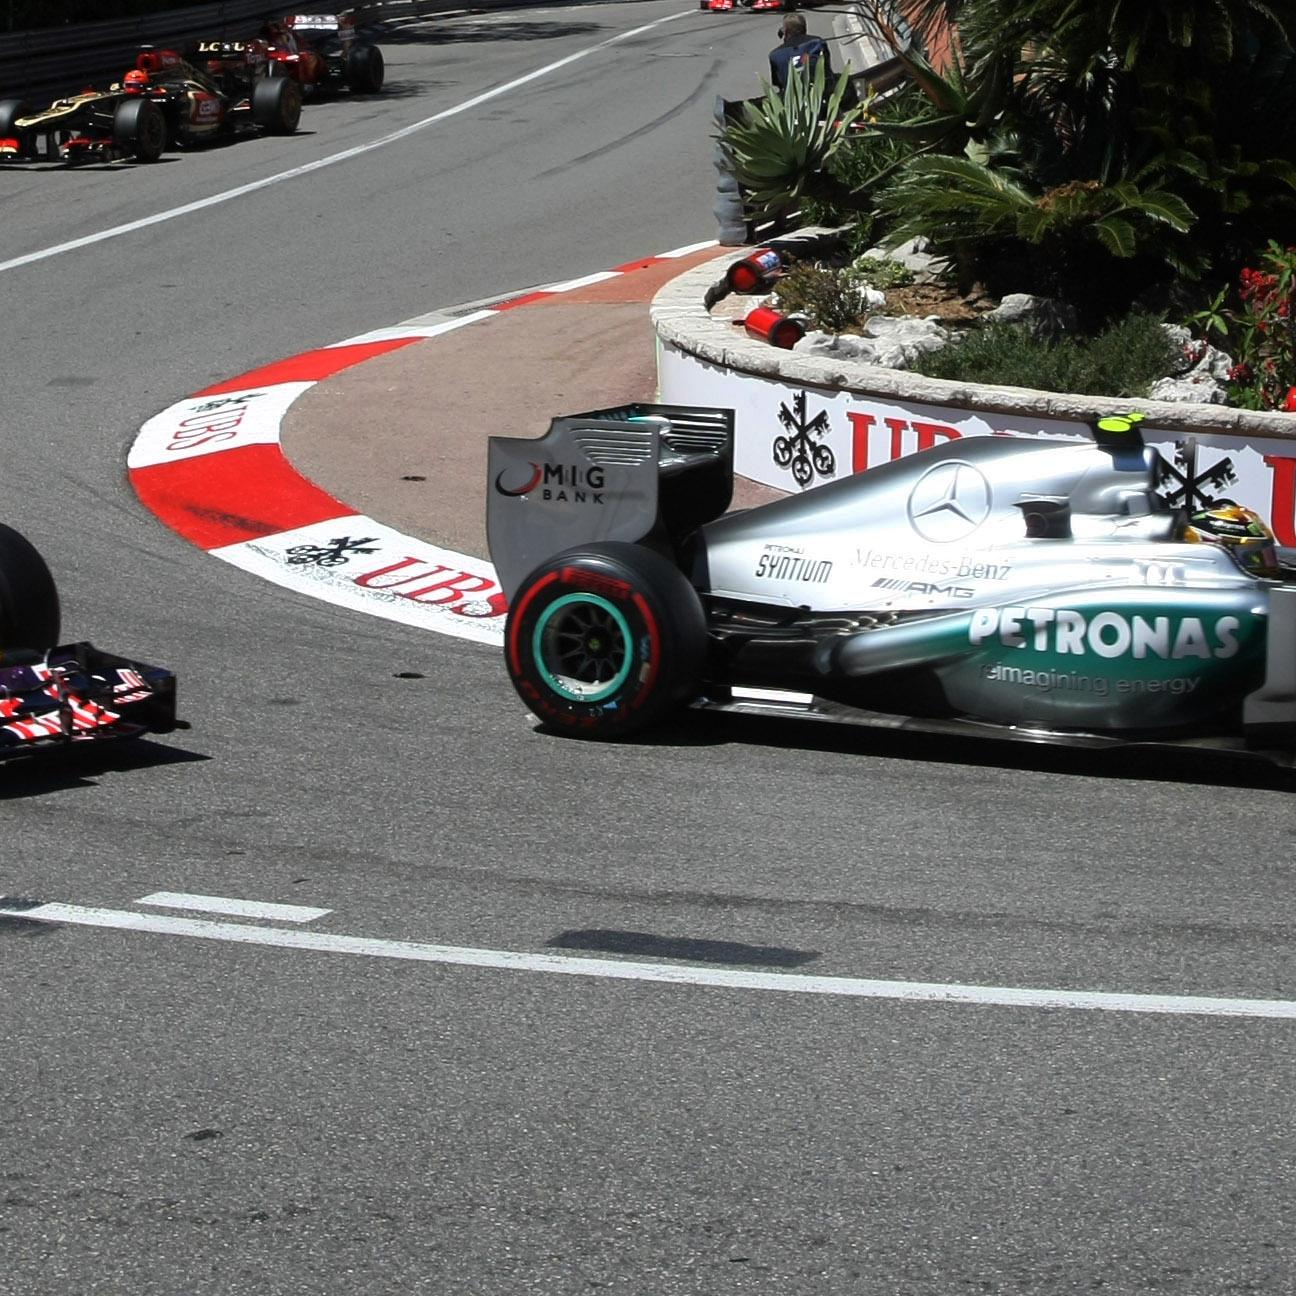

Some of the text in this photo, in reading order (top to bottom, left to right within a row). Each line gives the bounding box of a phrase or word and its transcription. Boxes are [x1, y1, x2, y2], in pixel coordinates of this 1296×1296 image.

[166, 405, 247, 450] UBS
[543, 463, 604, 489] MIG
[542, 489, 604, 504] BANK
[755, 554, 833, 584] SYNTIUM
[851, 549, 1012, 581] Mercedes-Benz
[353, 556, 508, 618] UBS
[907, 582, 976, 599] AMG
[968, 606, 1240, 659] PETRONAS
[978, 661, 1202, 697] reimagining energy
